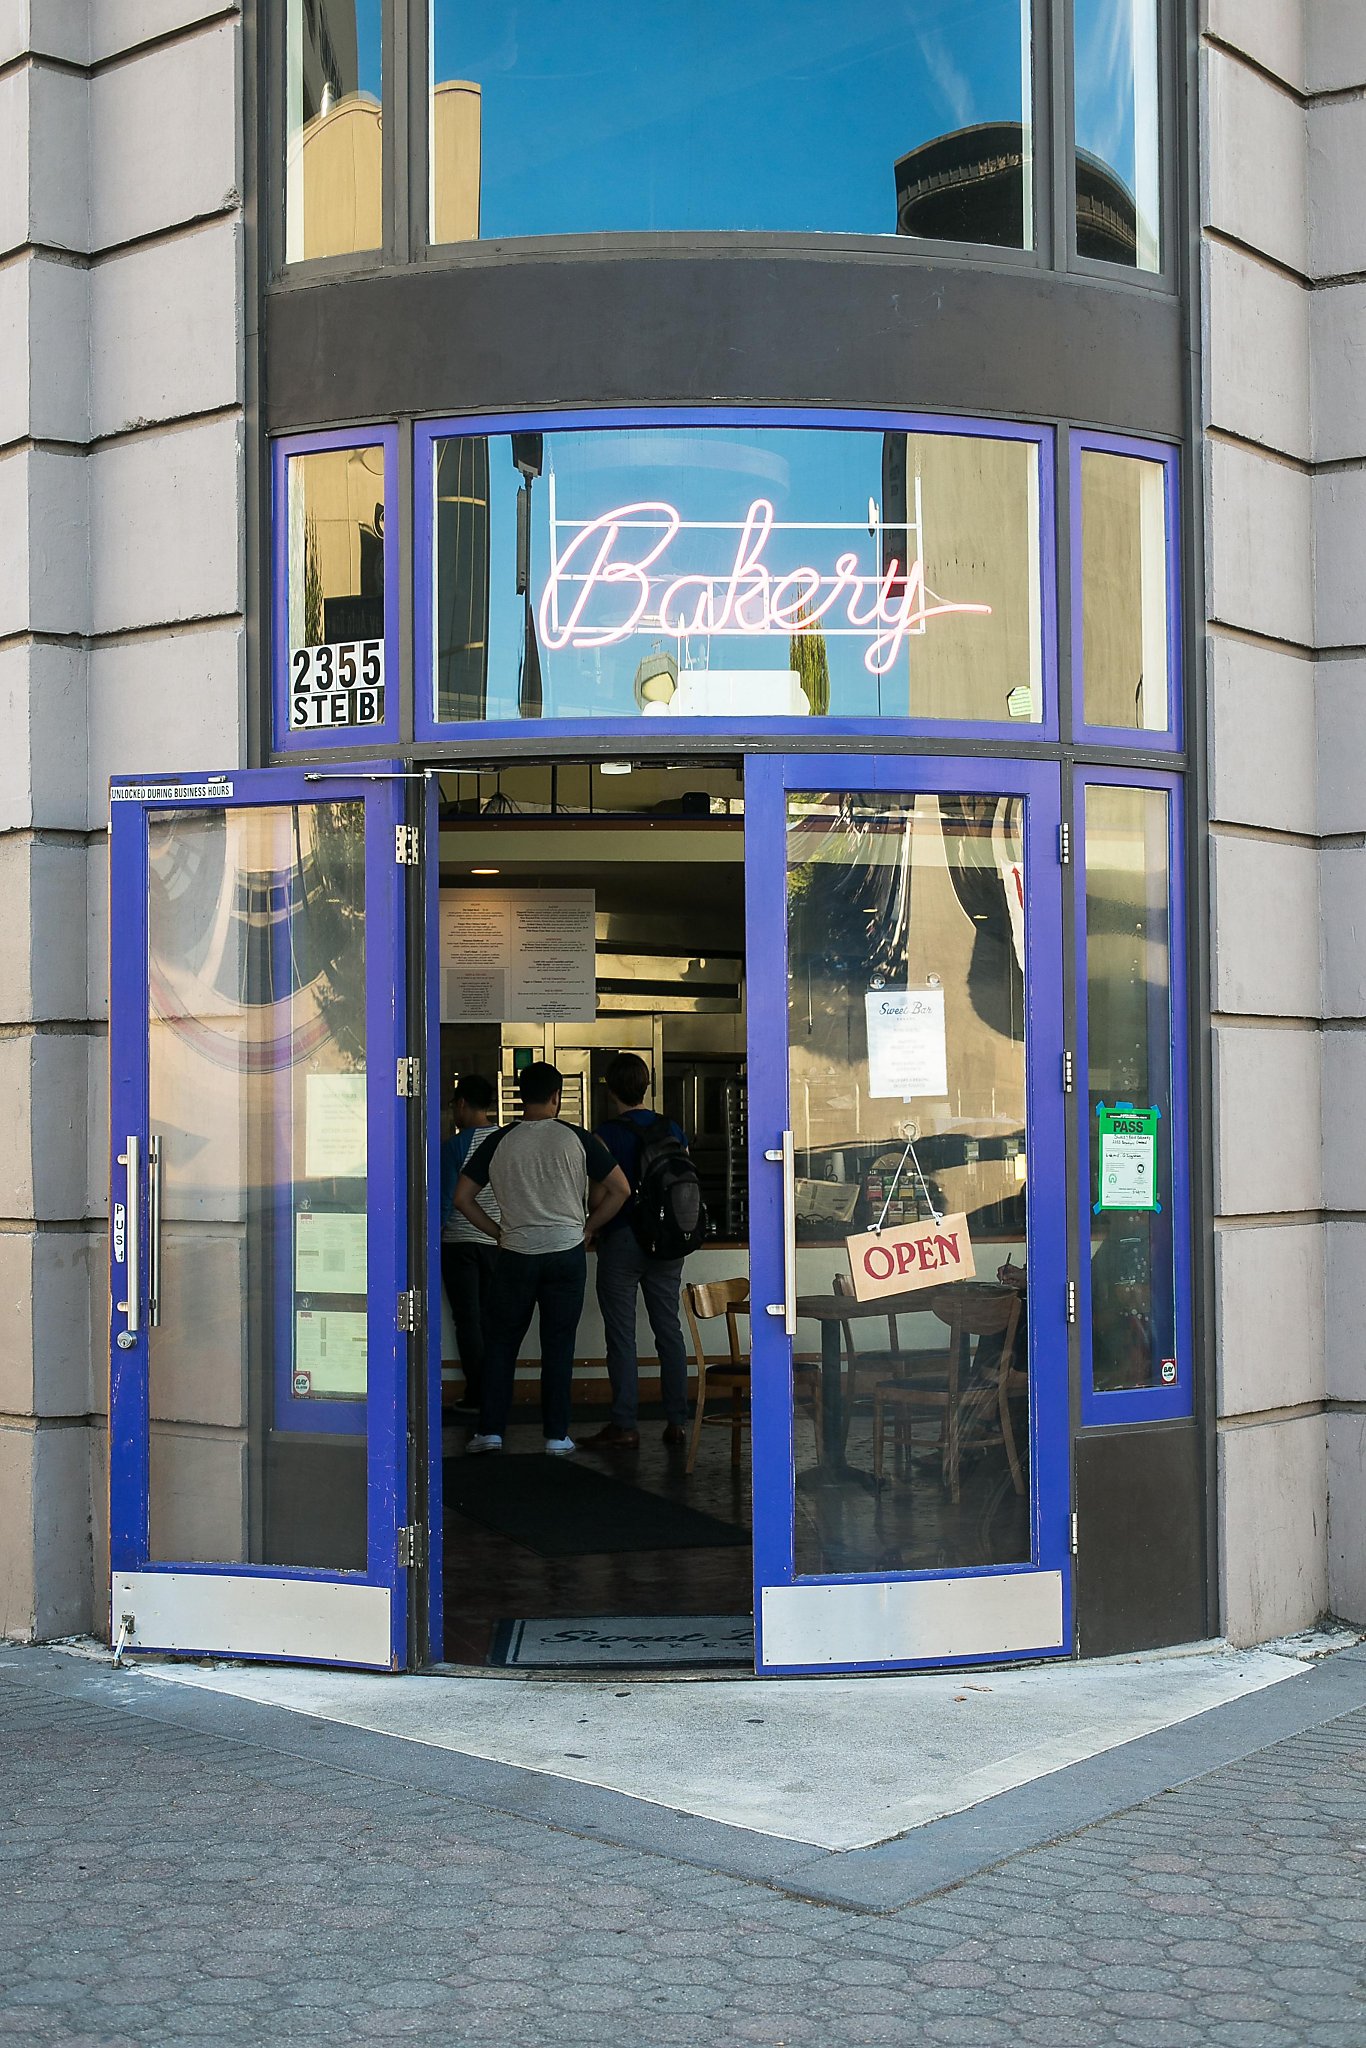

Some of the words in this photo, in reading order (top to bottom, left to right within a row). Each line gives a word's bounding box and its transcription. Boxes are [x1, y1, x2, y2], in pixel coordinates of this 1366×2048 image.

[539, 498, 992, 674] Bakery
[293, 641, 381, 694] 2355
[293, 693, 347, 725] STE
[359, 692, 375, 721] B
[111, 788, 146, 799] UNLOCKED
[147, 788, 173, 799] DURING
[174, 787, 206, 798] BUSINESS
[207, 785, 230, 797] HOURS
[879, 1001, 909, 1015] Sweet
[911, 1001, 933, 1015] Bar
[1113, 1120, 1144, 1133] PASS
[863, 1232, 961, 1280] OPEN
[540, 1629, 709, 1643] Sweet
